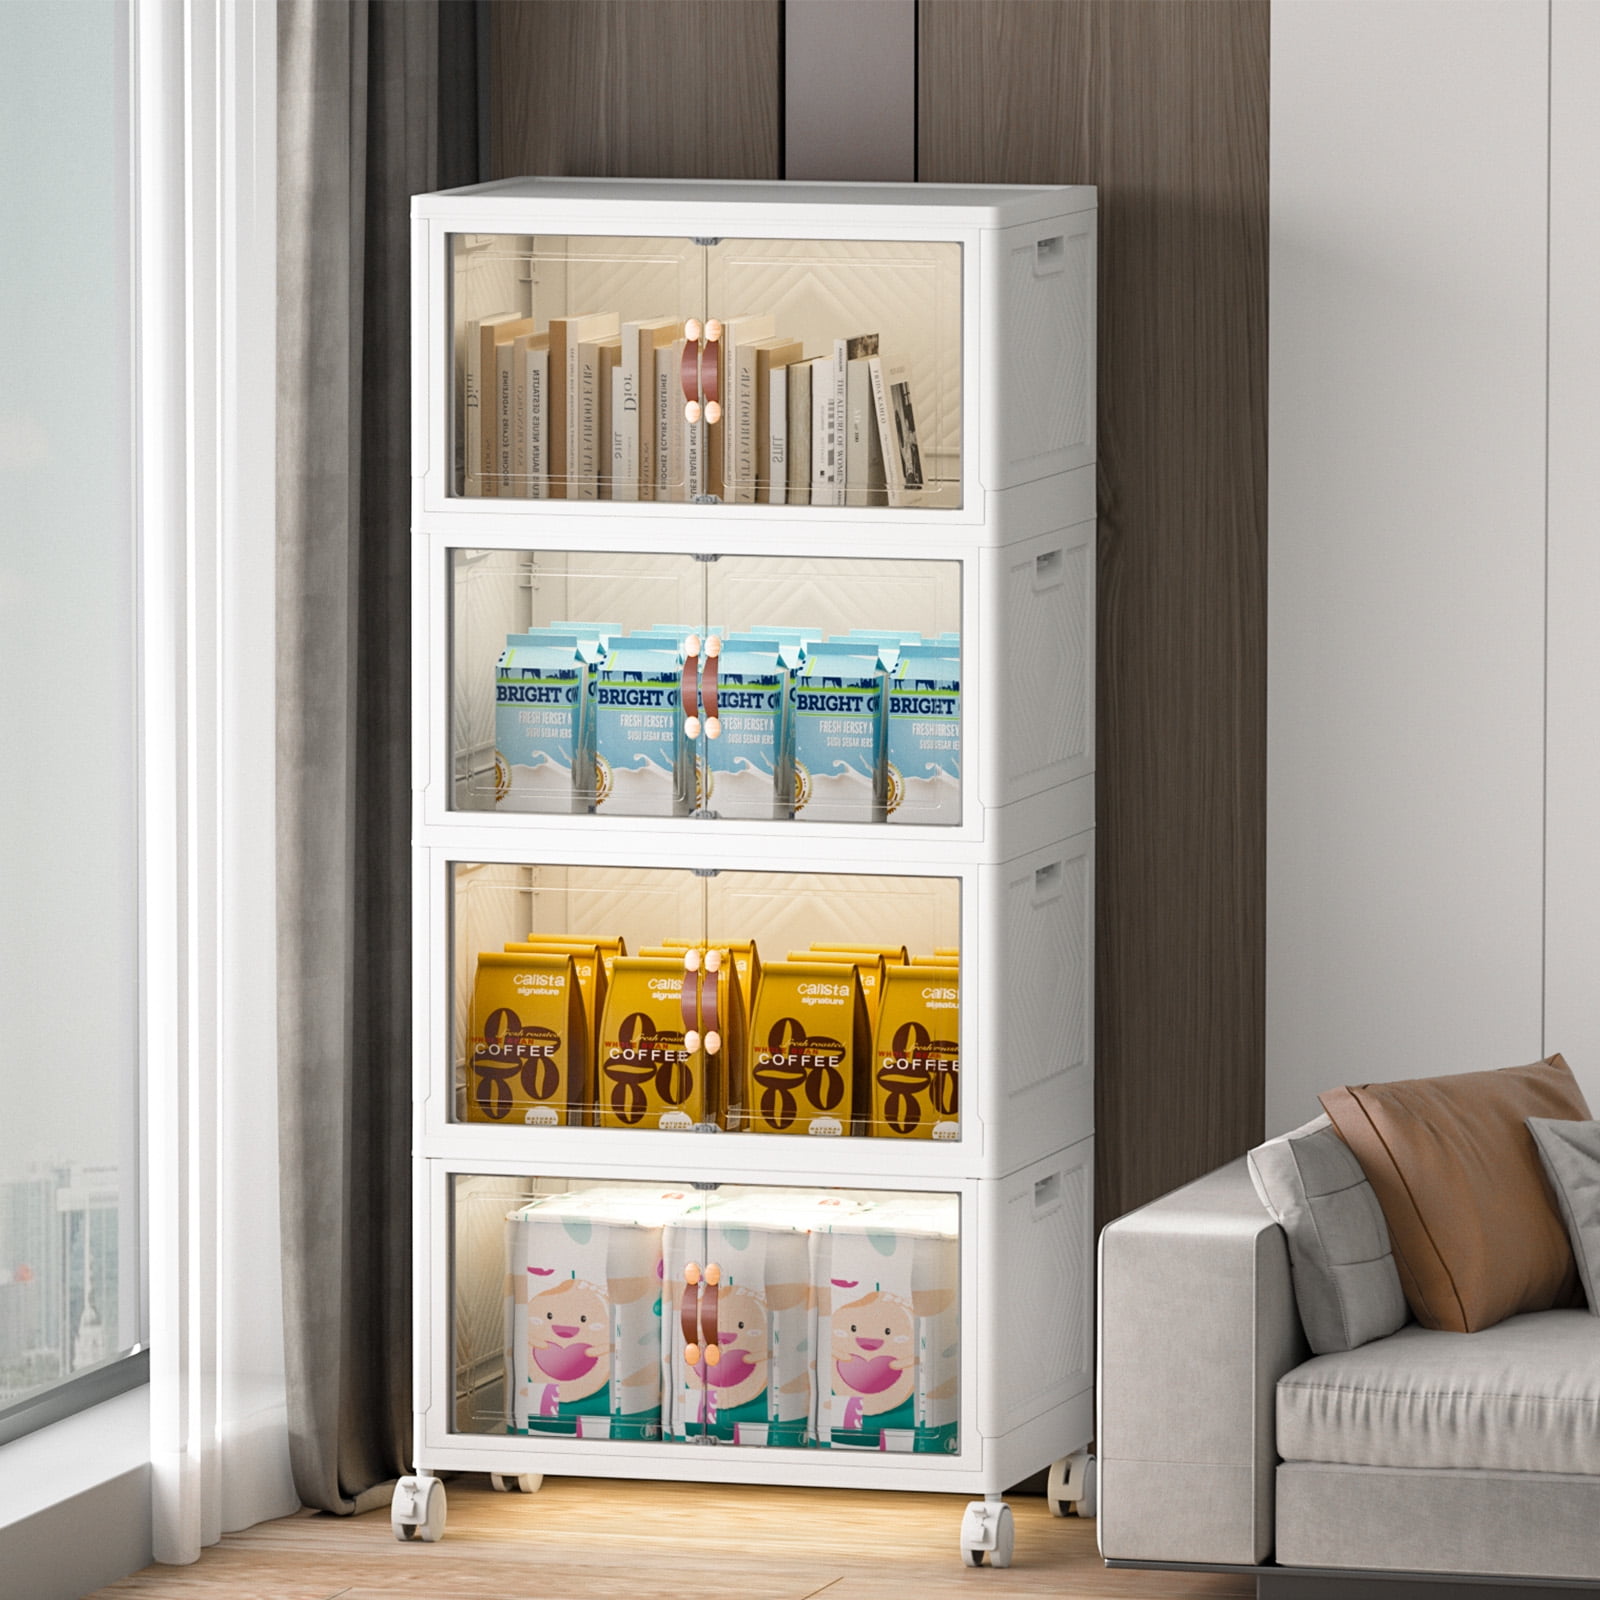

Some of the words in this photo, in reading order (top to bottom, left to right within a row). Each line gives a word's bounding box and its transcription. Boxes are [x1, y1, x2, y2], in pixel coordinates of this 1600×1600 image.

[836, 378, 845, 396] THE
[873, 369, 882, 394] FRIDA
[836, 398, 845, 435] ALLURE
[836, 436, 845, 448] OF
[496, 686, 562, 703] BRIGHT
[598, 689, 664, 706] BRIGHT
[797, 694, 863, 712] BRIGHT
[889, 697, 956, 714] BRIGHT
[513, 973, 565, 987] Calista
[647, 978, 683, 991] Calis
[517, 987, 560, 996] signature
[797, 983, 850, 997] Calista
[801, 996, 845, 1006] signature
[475, 1043, 555, 1057] COFFEE
[609, 1047, 689, 1062] COFFEE
[759, 1053, 839, 1067] COFFEE
[882, 1057, 960, 1072] COFFEE
